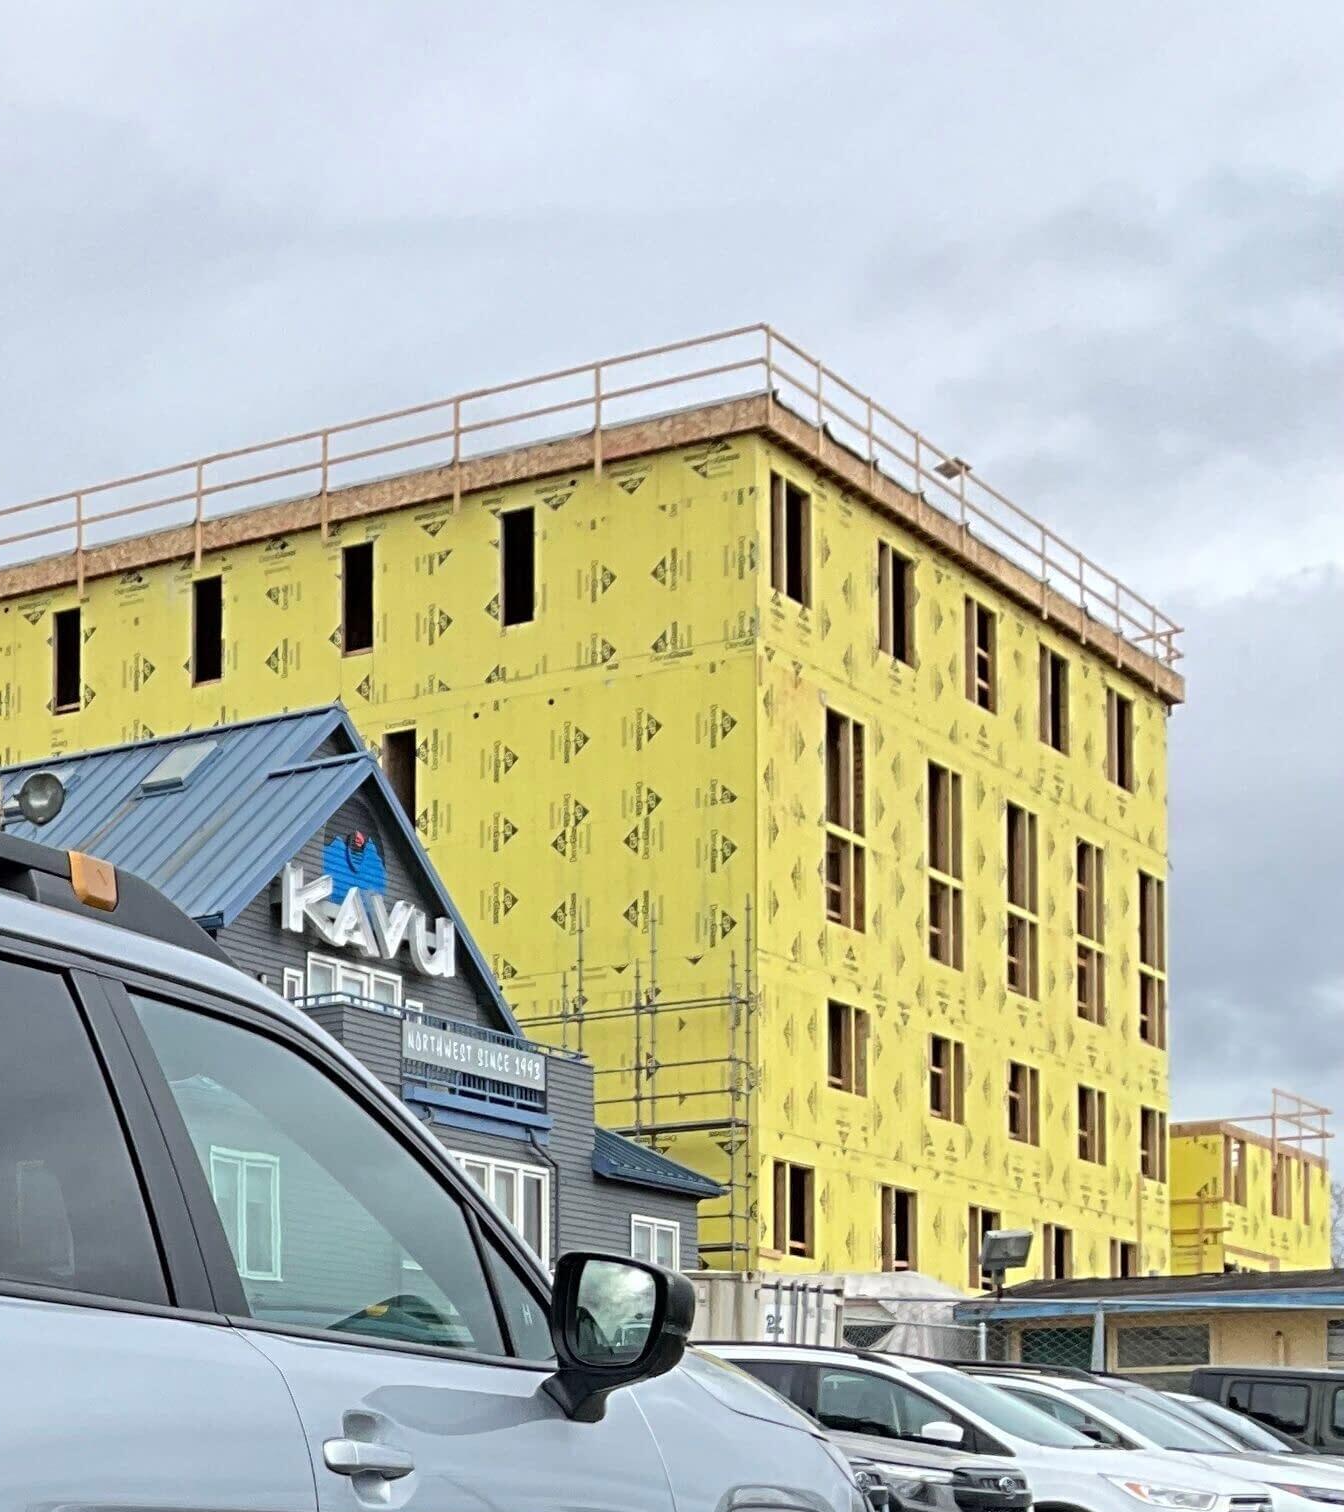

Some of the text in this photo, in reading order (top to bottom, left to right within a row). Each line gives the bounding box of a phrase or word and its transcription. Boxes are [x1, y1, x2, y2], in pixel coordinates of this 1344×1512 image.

[407, 1031, 541, 1081] NORTHWEST SINCE 1993
